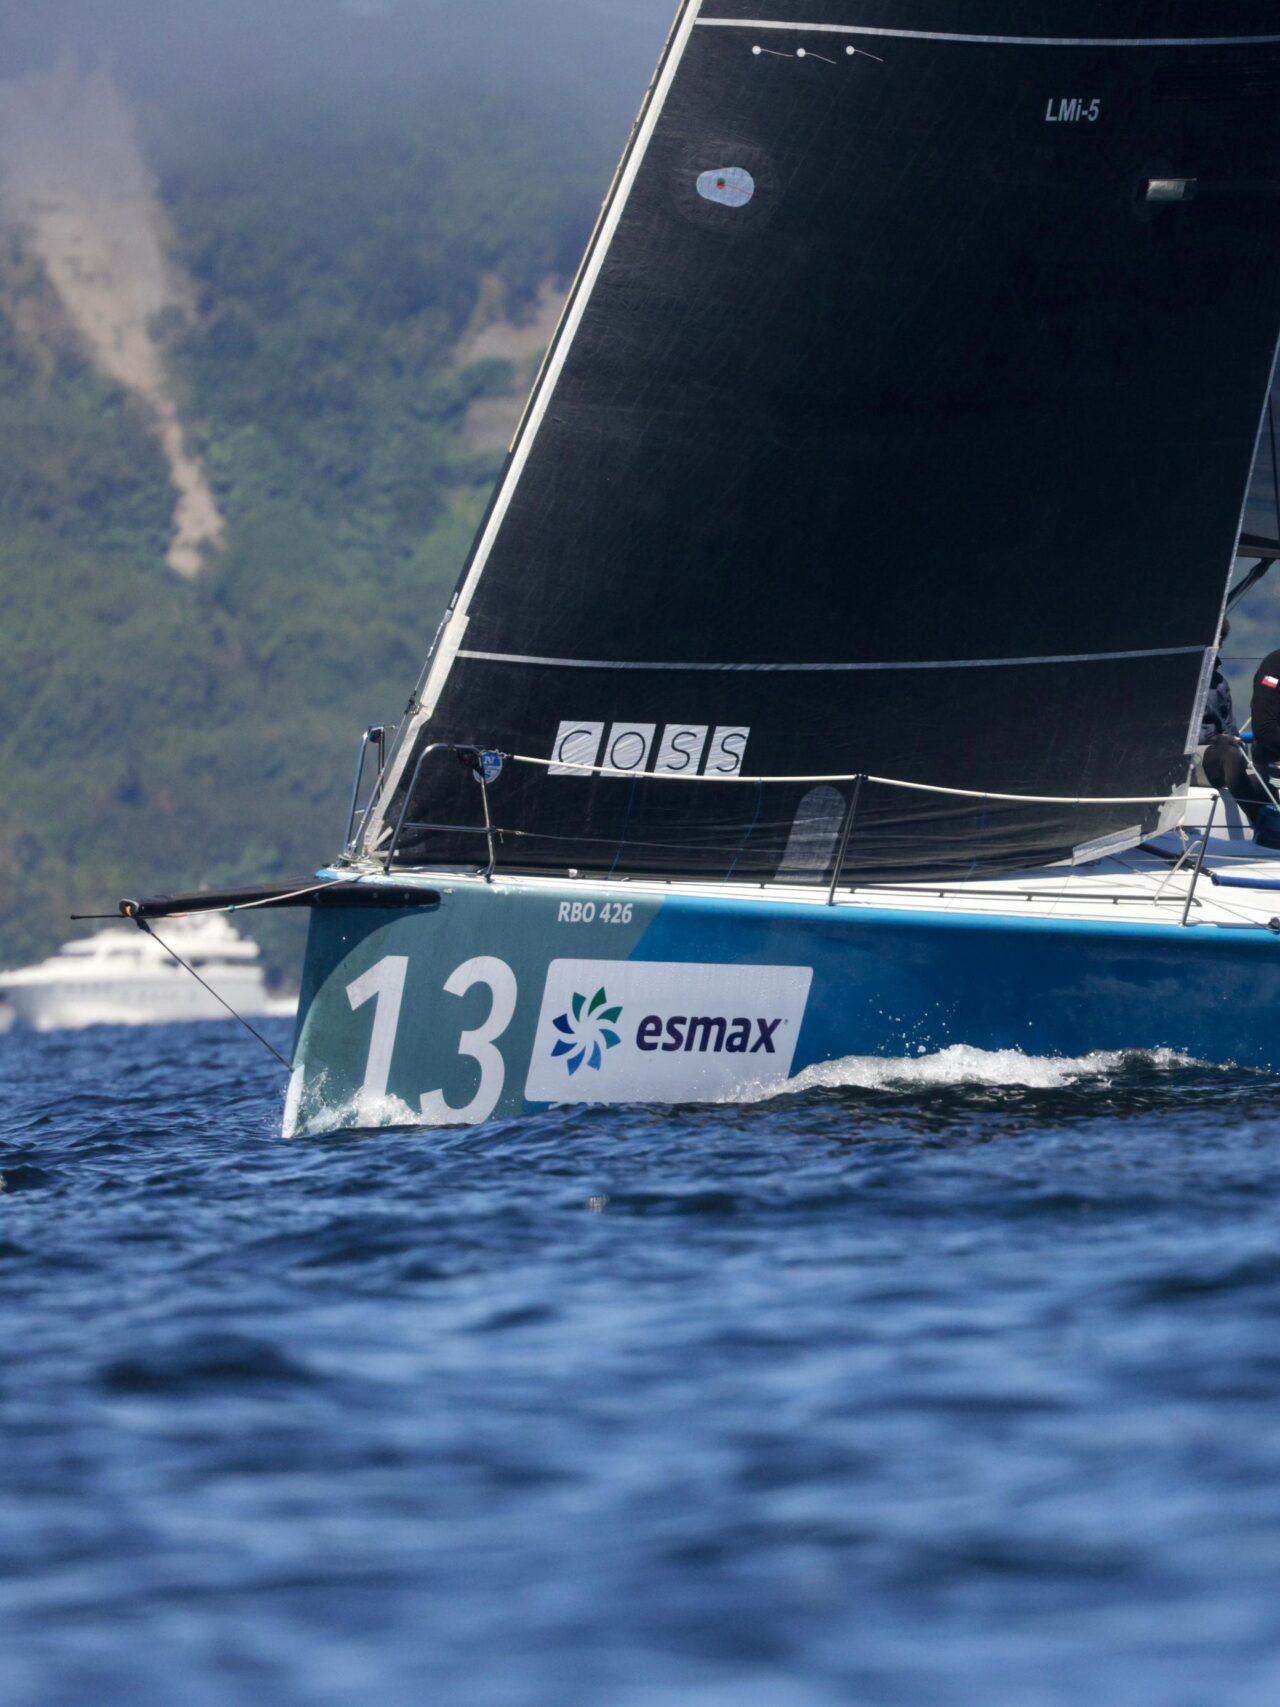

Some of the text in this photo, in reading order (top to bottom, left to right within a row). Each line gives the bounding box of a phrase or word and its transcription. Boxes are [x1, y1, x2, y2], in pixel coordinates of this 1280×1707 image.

[1045, 98, 1101, 121] LMi-5
[558, 729, 747, 773] COSS
[557, 901, 634, 924] RBO 426
[345, 955, 518, 1125] 13
[636, 1014, 783, 1054] esmax
